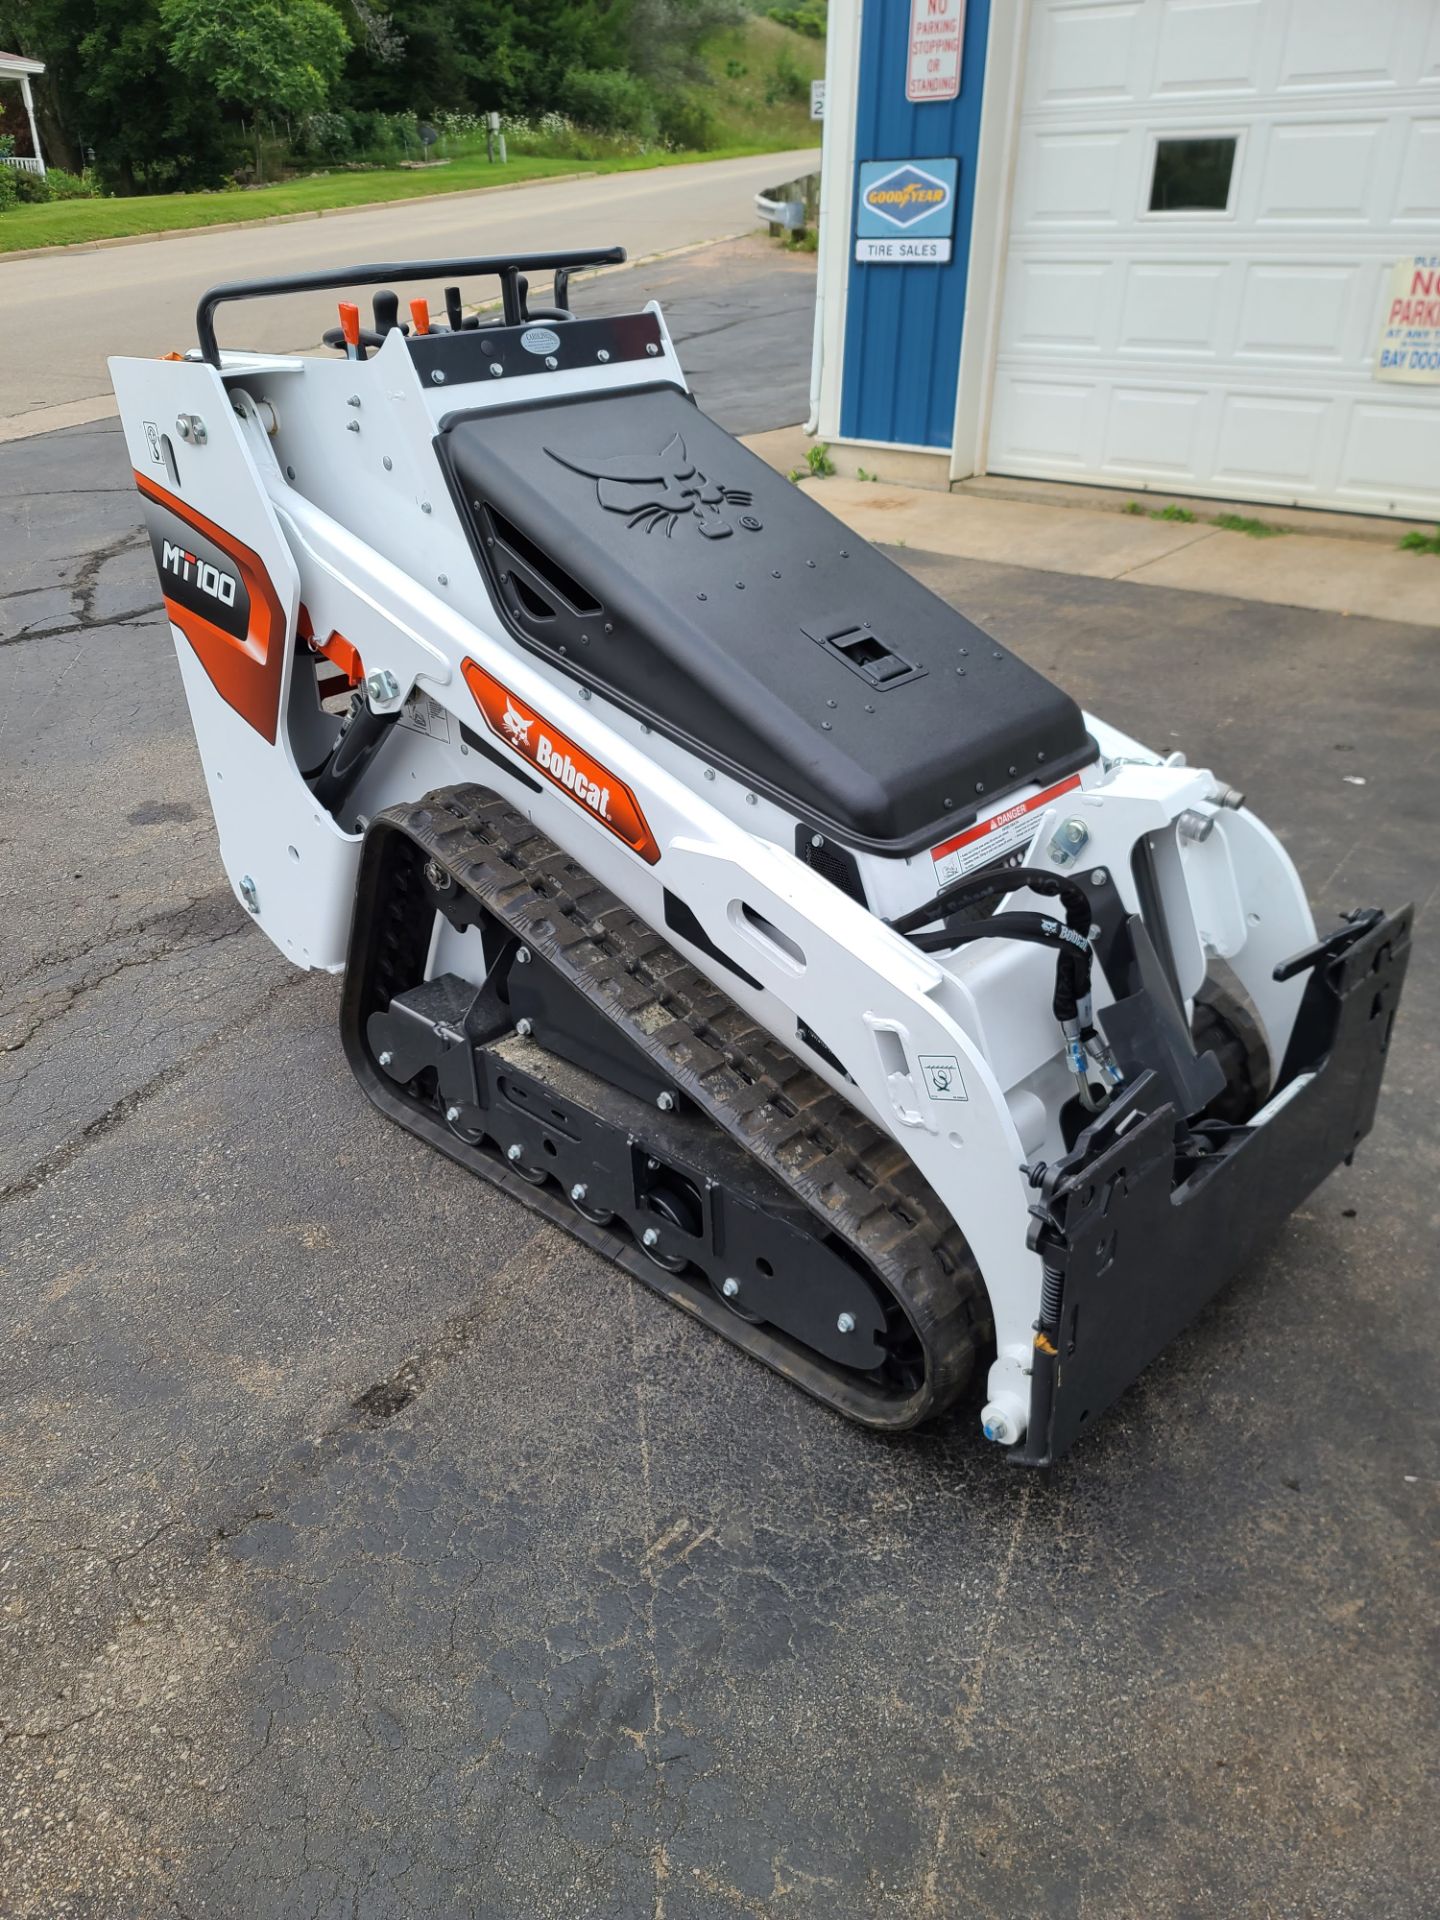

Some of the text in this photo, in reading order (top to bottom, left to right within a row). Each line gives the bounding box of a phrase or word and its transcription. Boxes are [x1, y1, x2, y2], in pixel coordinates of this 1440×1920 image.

[927, 0, 947, 15] NO
[916, 19, 956, 34] PARKING
[912, 38, 959, 55] STOPPING
[927, 58, 940, 73] OR
[910, 76, 956, 93] STANDING
[868, 183, 944, 208] GOODYEAR
[868, 244, 937, 256] TIRE SALES
[1414, 256, 1440, 267] PLE
[1380, 349, 1440, 370] BAY DOO
[162, 540, 236, 608] MT100
[536, 734, 610, 819] Bobcat
[996, 803, 1027, 826] DANGER
